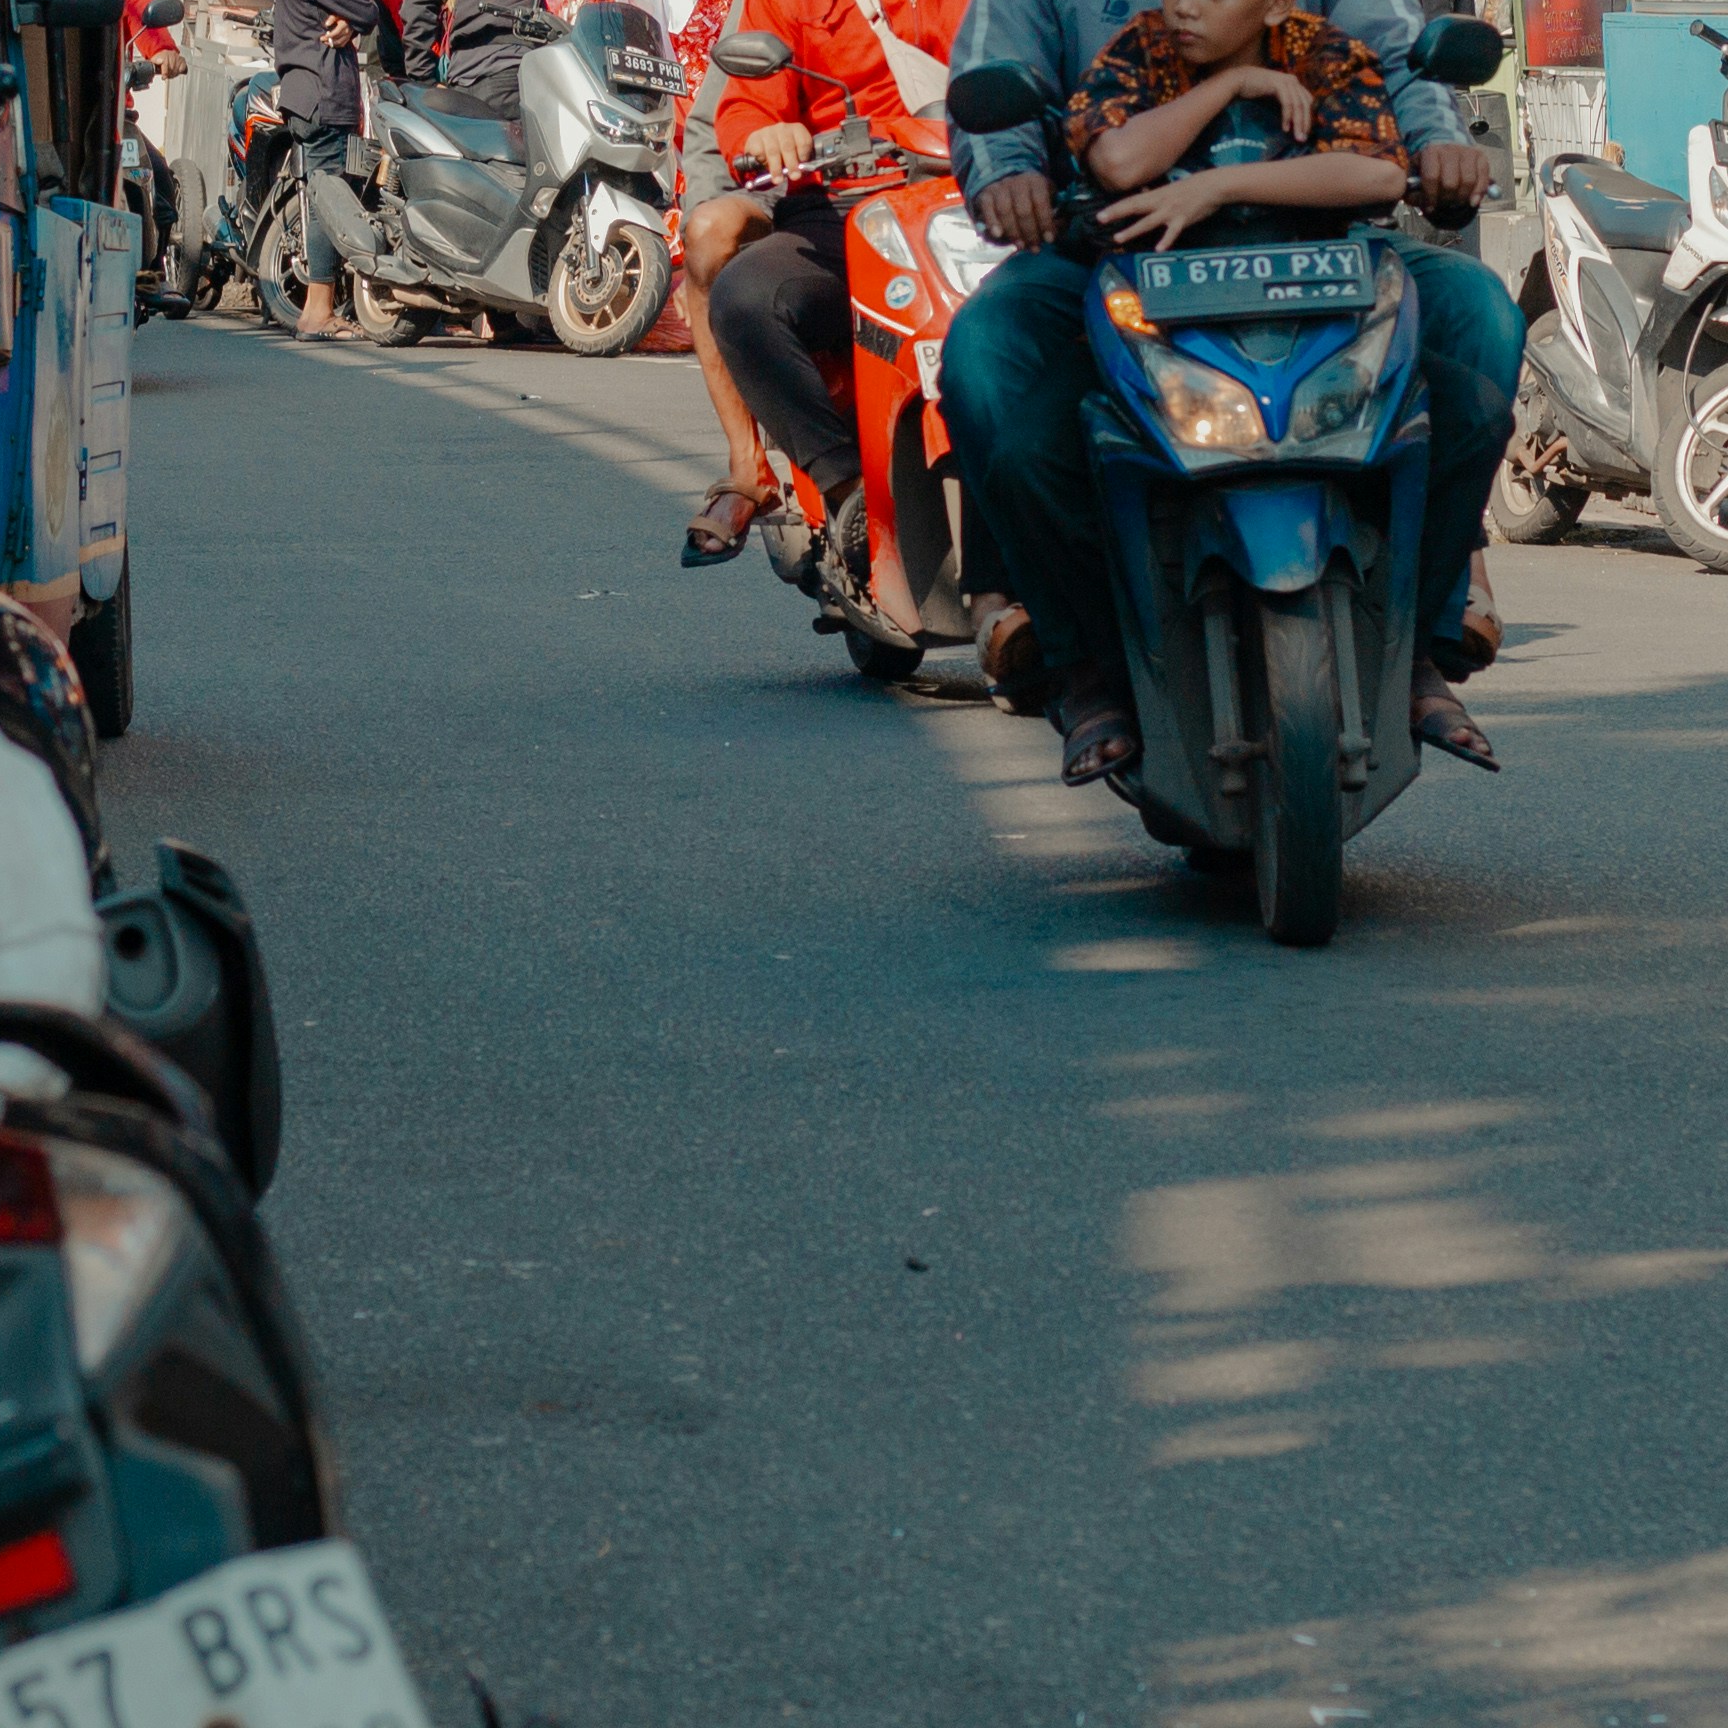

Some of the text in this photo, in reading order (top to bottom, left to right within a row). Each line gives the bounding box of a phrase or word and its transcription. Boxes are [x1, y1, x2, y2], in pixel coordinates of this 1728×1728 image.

[611, 52, 620, 66] B
[658, 62, 681, 80] PKR
[1680, 239, 1705, 264] HONDA
[1150, 250, 1356, 288] B 6720 PXY
[922, 345, 940, 368] B
[180, 1574, 371, 1697] BRS
